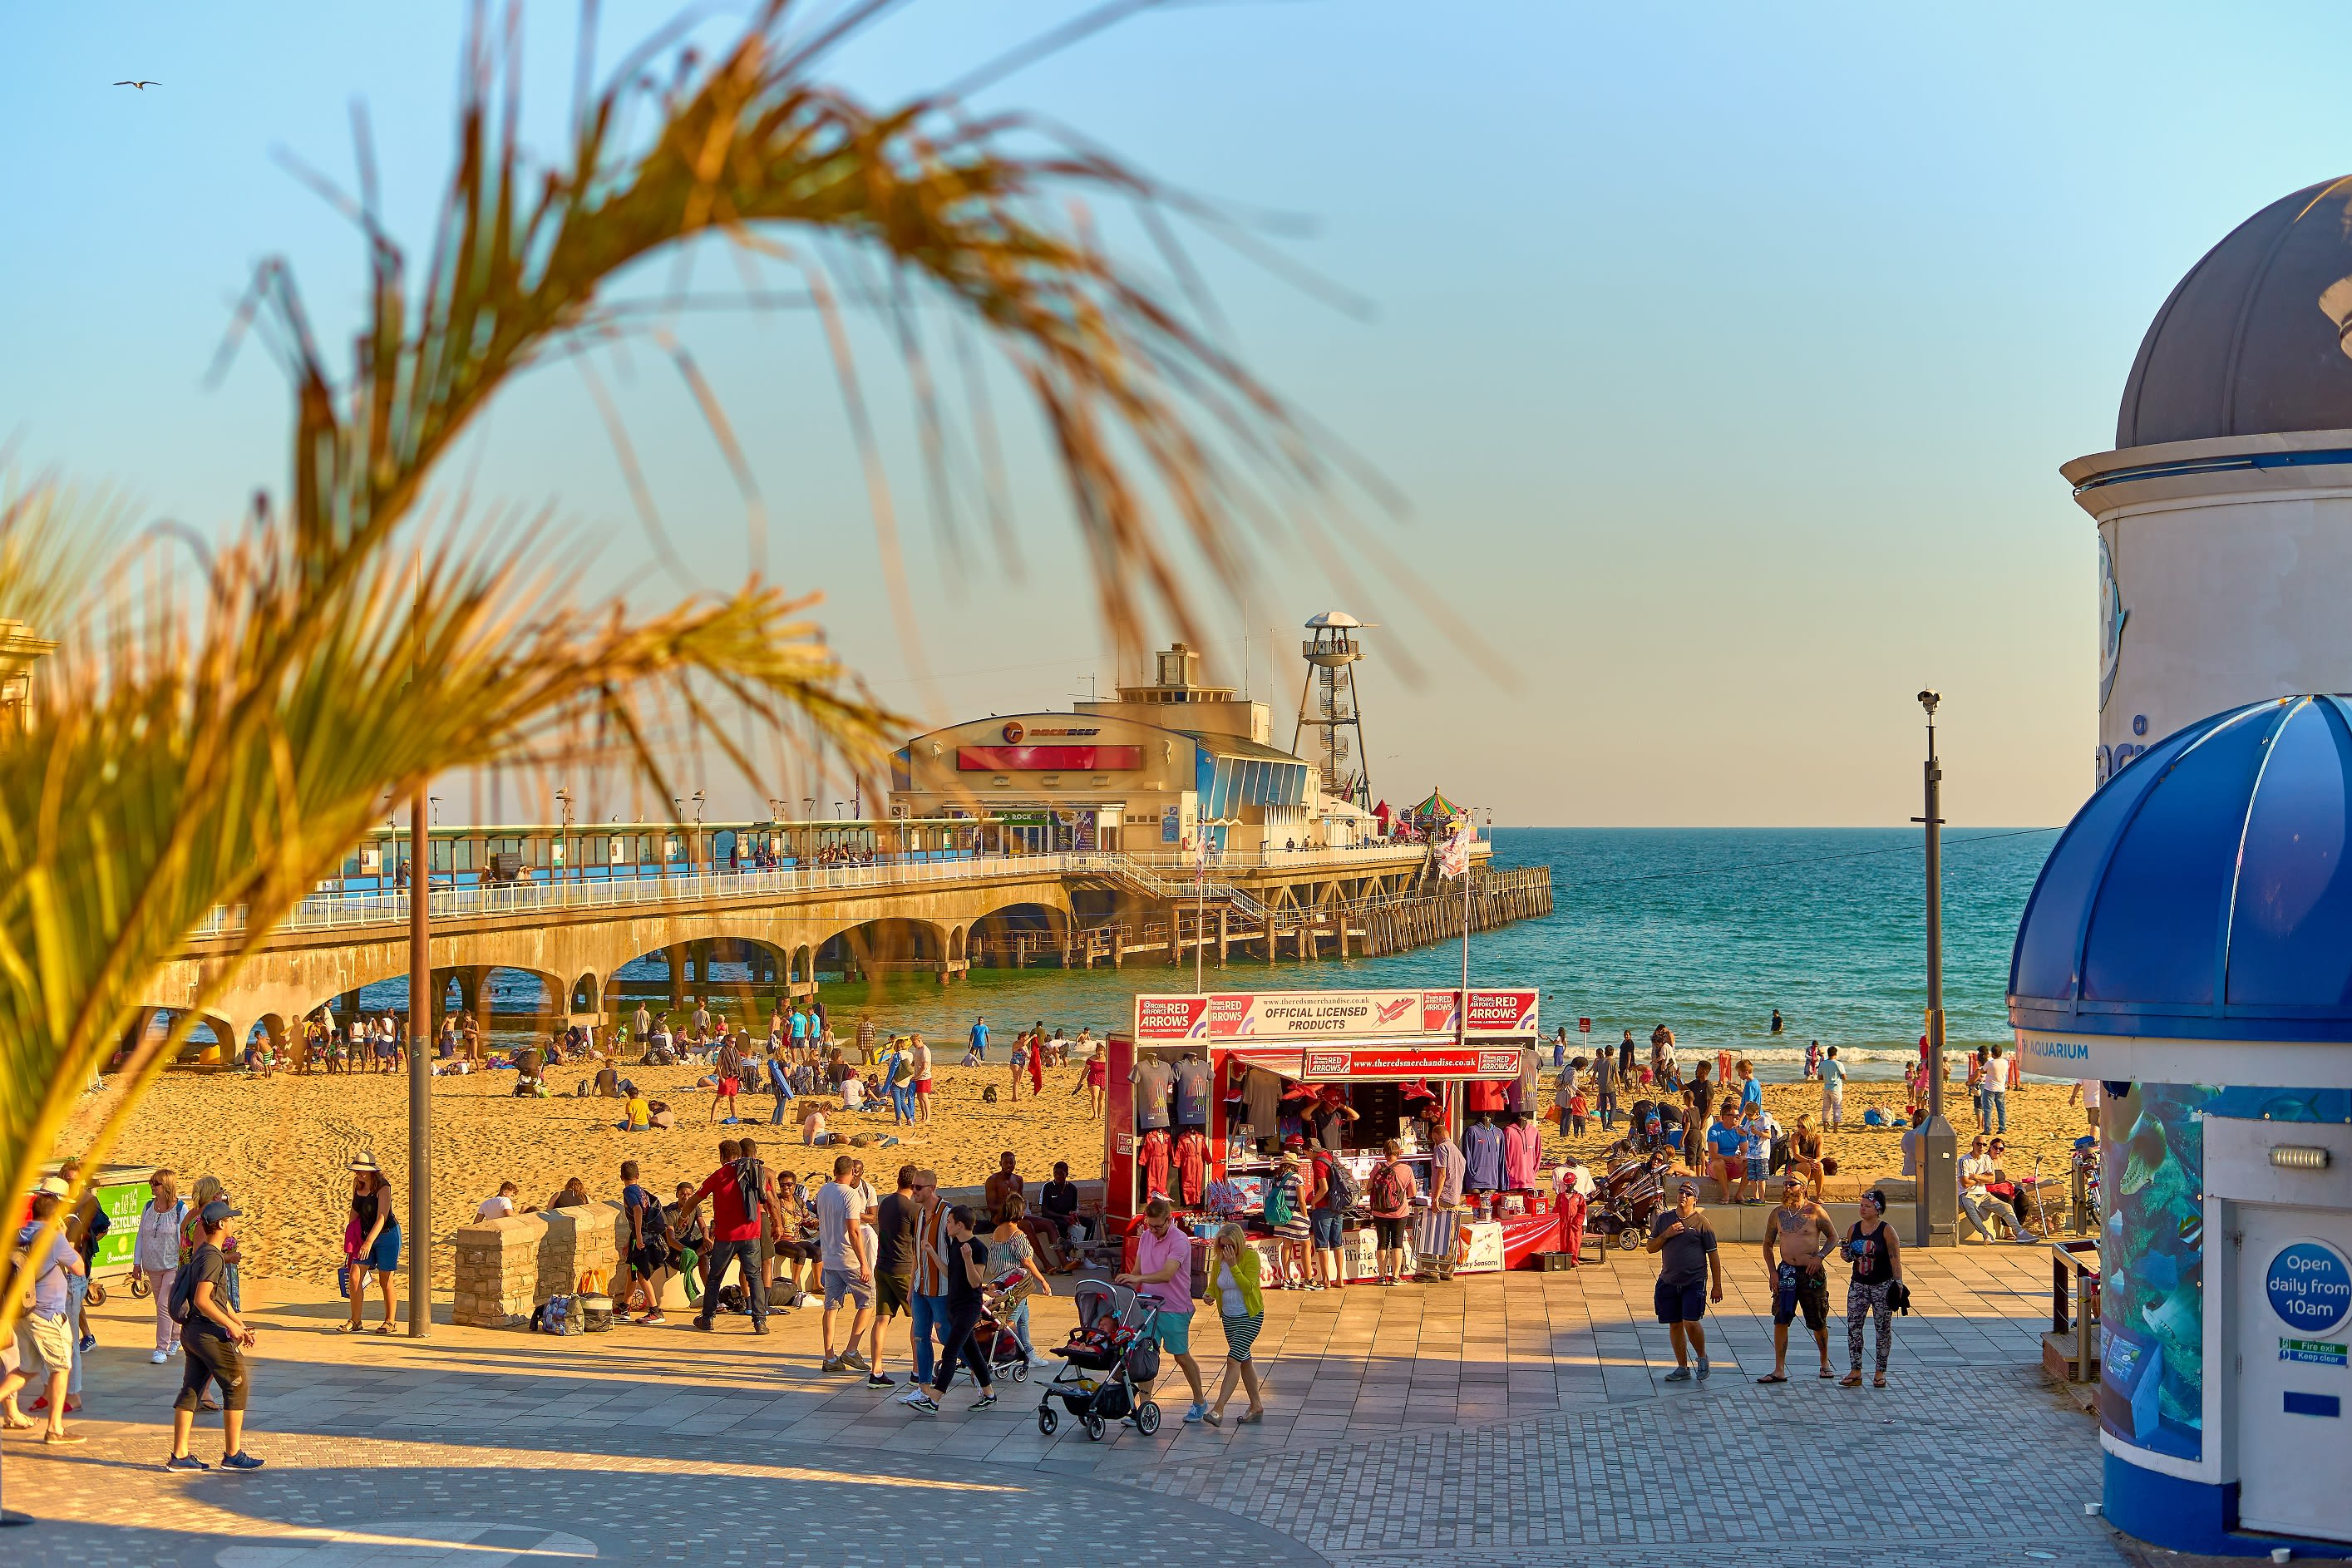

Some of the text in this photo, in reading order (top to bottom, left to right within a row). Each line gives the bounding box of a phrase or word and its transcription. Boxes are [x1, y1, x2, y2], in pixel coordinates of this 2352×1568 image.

[1263, 997, 1370, 1005] www.theredsmerchandise.co.uk
[1438, 995, 1452, 1003] RED
[1495, 996, 1517, 1007] RED
[1166, 1003, 1190, 1014] RED
[1225, 1000, 1242, 1011] RED
[1424, 1003, 1452, 1011] ARROWS
[1211, 1011, 1242, 1022] RROWS
[1265, 1006, 1368, 1018] OFFICIAL LICENSED
[1468, 1008, 1517, 1019] ARROWS
[1140, 1015, 1189, 1027] ARROWS
[1288, 1019, 1346, 1031] PRODUCTS
[2029, 1040, 2088, 1059] AQUARIUM
[1354, 1057, 1476, 1068] www.theredsmerchandise.co.uk
[1497, 1055, 1510, 1063] RED
[1480, 1063, 1509, 1071] ARROWS
[1345, 1248, 1378, 1261] fficial
[2286, 1255, 2331, 1273] Open
[2270, 1277, 2350, 1295] daily from
[2286, 1299, 2334, 1317] 10am
[2301, 1341, 2335, 1353] Fire exit
[2298, 1352, 2340, 1363] Keep clear
